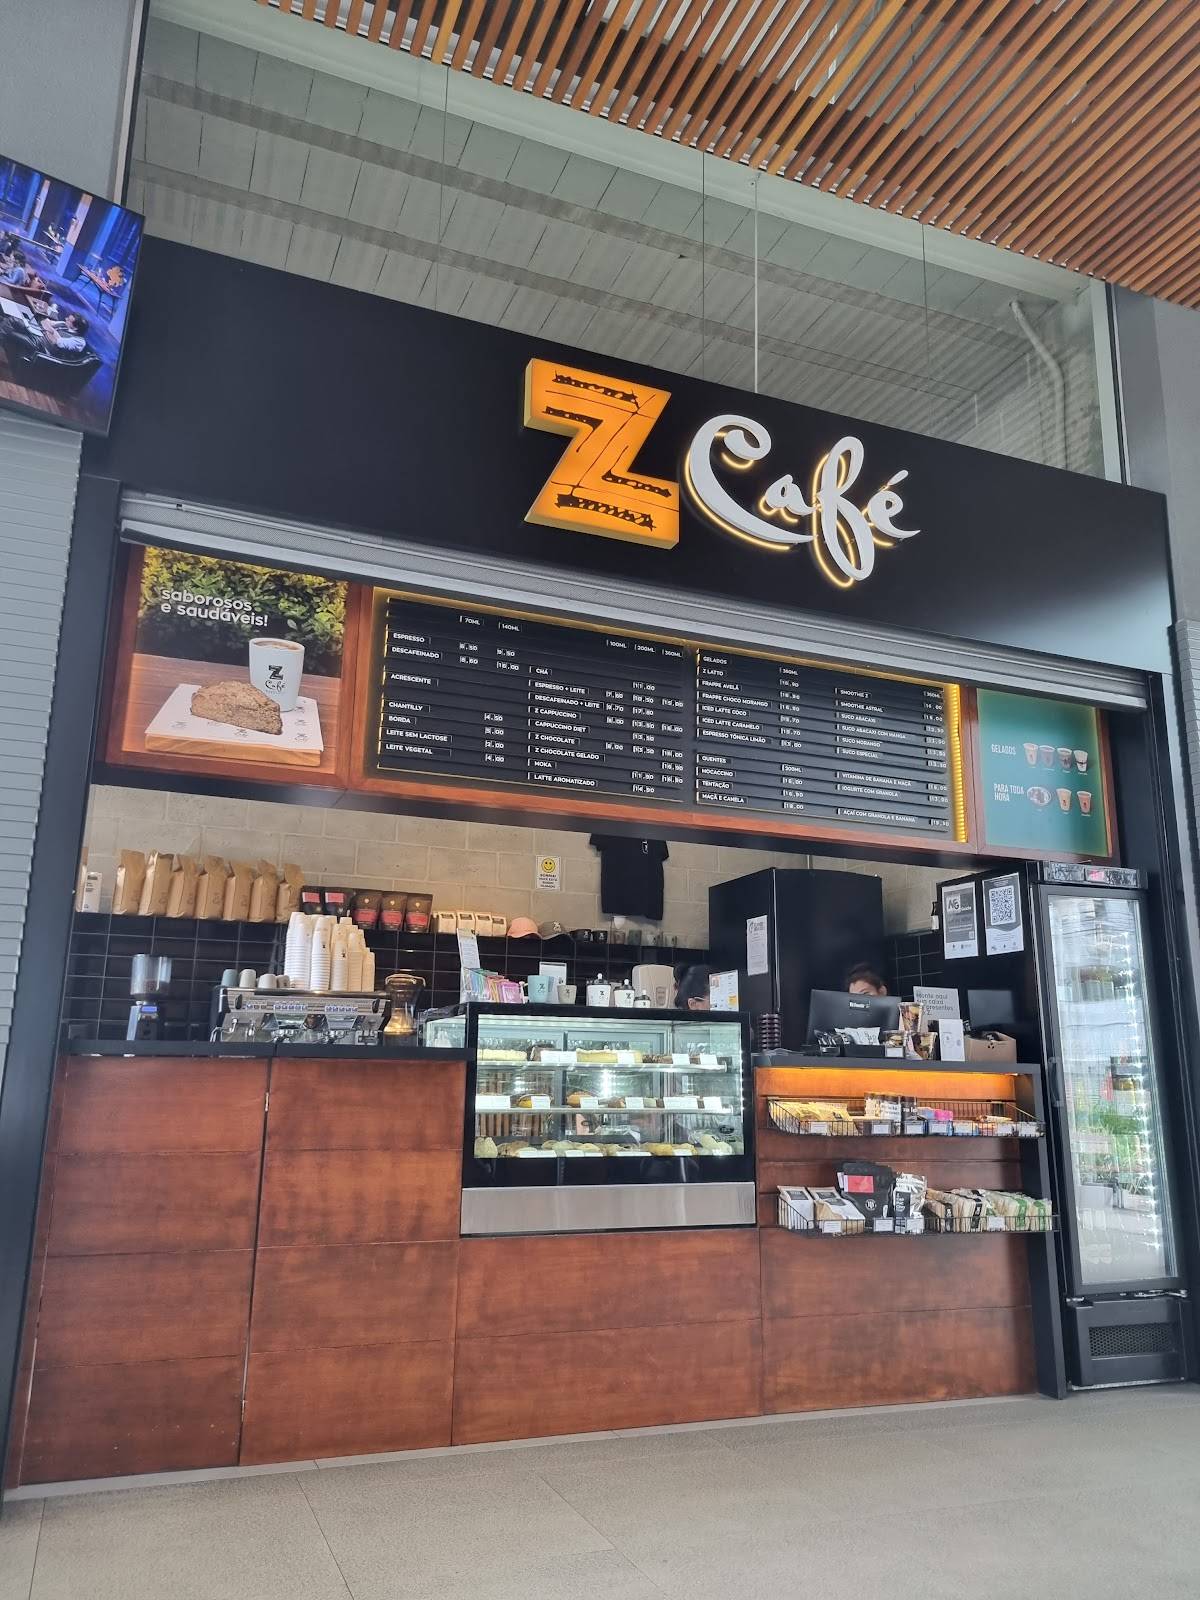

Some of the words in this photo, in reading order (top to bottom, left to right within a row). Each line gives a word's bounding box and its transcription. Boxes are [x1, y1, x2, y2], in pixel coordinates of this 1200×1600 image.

[523, 357, 680, 550] Z
[687, 414, 921, 583] Café
[162, 589, 253, 611] saborosos
[161, 604, 171, 613] e
[177, 604, 268, 627] saudáveis!
[465, 618, 480, 626] 70ML
[502, 623, 520, 632] 140ML
[393, 633, 424, 643] ESPRESSO
[392, 646, 440, 659] DESCAFEINADO
[703, 656, 727, 665] GELADOS
[268, 665, 284, 680] Z
[536, 667, 549, 675] CHÁ
[391, 673, 431, 685] ACRESCENTE
[535, 681, 564, 691] ESPRESSO
[840, 690, 864, 698] SMOOTHIE
[535, 694, 578, 706] DESCAFEINADO
[723, 696, 741, 704] CHOCO
[742, 698, 768, 707] MORANGO
[389, 702, 423, 711] CHANTILLY
[841, 702, 865, 710] SMOOTHIE
[540, 709, 577, 719] CAPPUCCINO
[389, 716, 410, 724] BORDA
[715, 719, 731, 727] LATTE
[732, 721, 760, 730] CARAMELO
[535, 721, 572, 730] CAPPUCCINO
[387, 729, 403, 737] LEITE
[405, 731, 418, 739] SEM
[420, 733, 447, 742] LACTOSE
[856, 727, 876, 735] ABACAXI
[540, 735, 575, 744] CHOCOLATE
[702, 730, 729, 738] ESPRESSO
[730, 732, 749, 741] TÔNICA
[750, 735, 766, 744] LIMÃO
[856, 739, 881, 747] MORANGO
[386, 744, 403, 752] LEITE
[405, 746, 433, 755] VEGETAL
[540, 748, 575, 757] CHOCOLATE
[576, 752, 599, 760] GELADO
[991, 744, 1016, 755] GELADOS
[702, 756, 726, 764] QUENTES
[856, 751, 878, 759] ESPECIAL
[702, 768, 733, 777] MOCACCINO
[553, 777, 595, 786] AROMATIZADO
[842, 773, 865, 781] VITAMINA
[873, 776, 893, 784] BANANA
[702, 780, 730, 789] TENTAÇÃO
[993, 783, 1008, 792] PARA
[1010, 785, 1024, 794] TODA
[702, 792, 718, 800] MAÇÃ
[876, 789, 898, 797] GRANOLA
[994, 793, 1010, 802] HORA
[843, 809, 855, 817] AÇAÍ
[868, 812, 890, 820] GRANOLA
